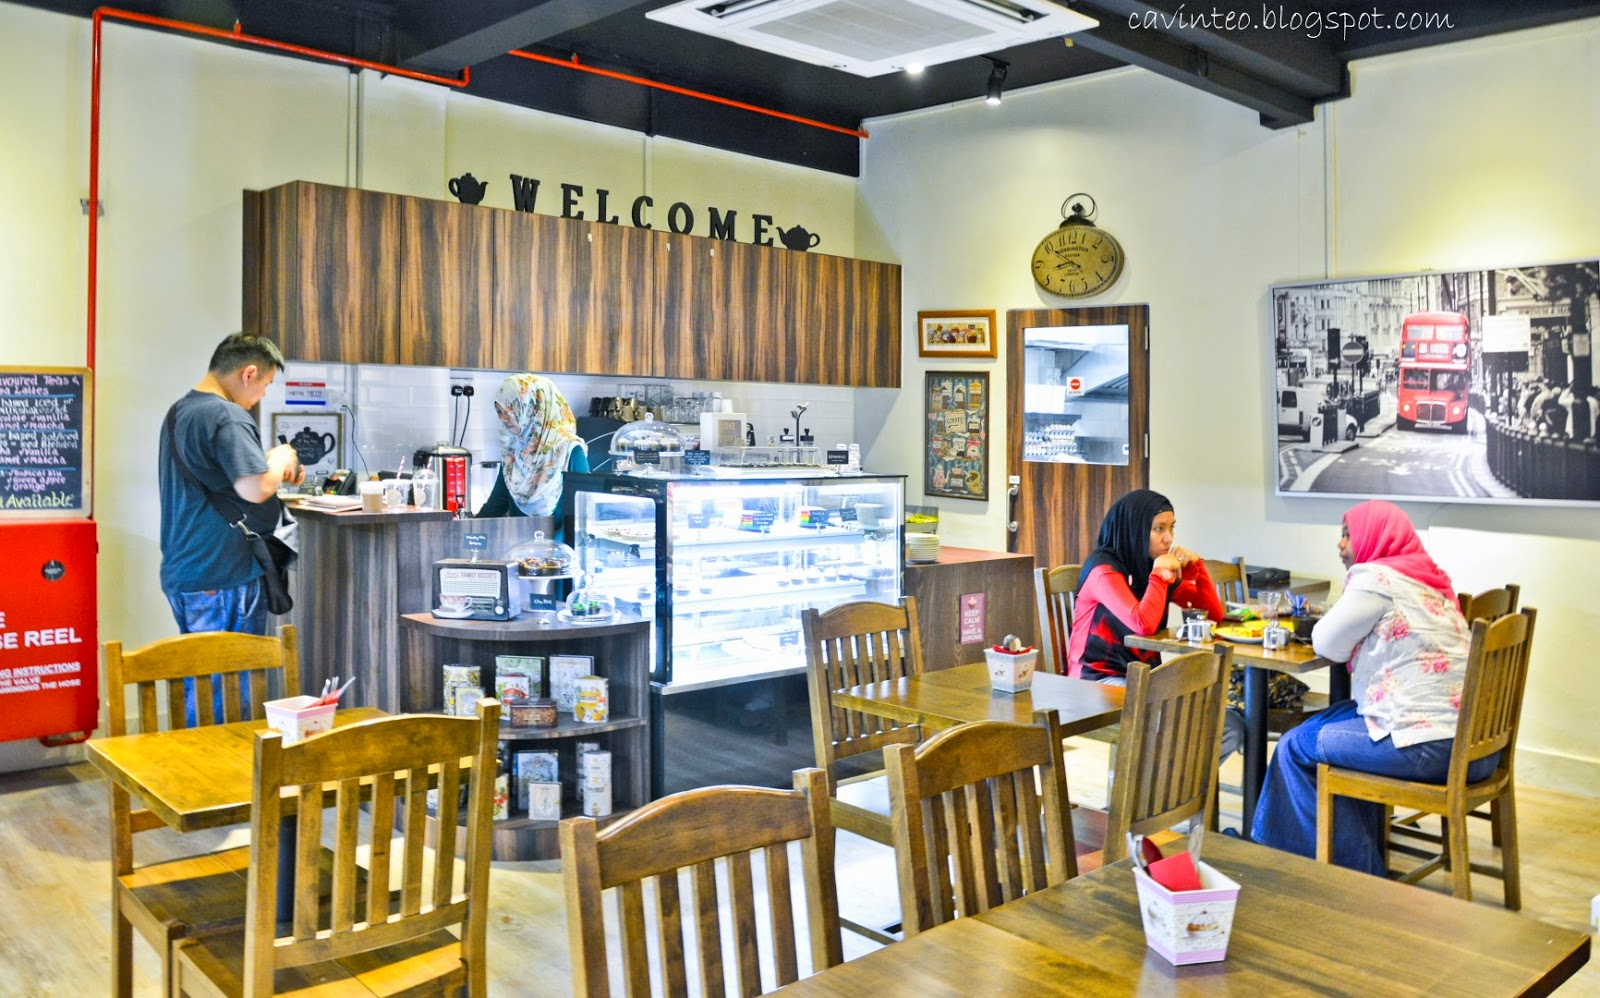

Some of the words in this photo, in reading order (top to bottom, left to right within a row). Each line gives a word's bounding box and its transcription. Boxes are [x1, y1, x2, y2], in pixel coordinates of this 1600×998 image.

[509, 173, 775, 247] WELCOME
[5, 490, 75, 508] Available
[24, 627, 83, 648] REEL
[13, 661, 81, 678] INSTRUCTIONS
